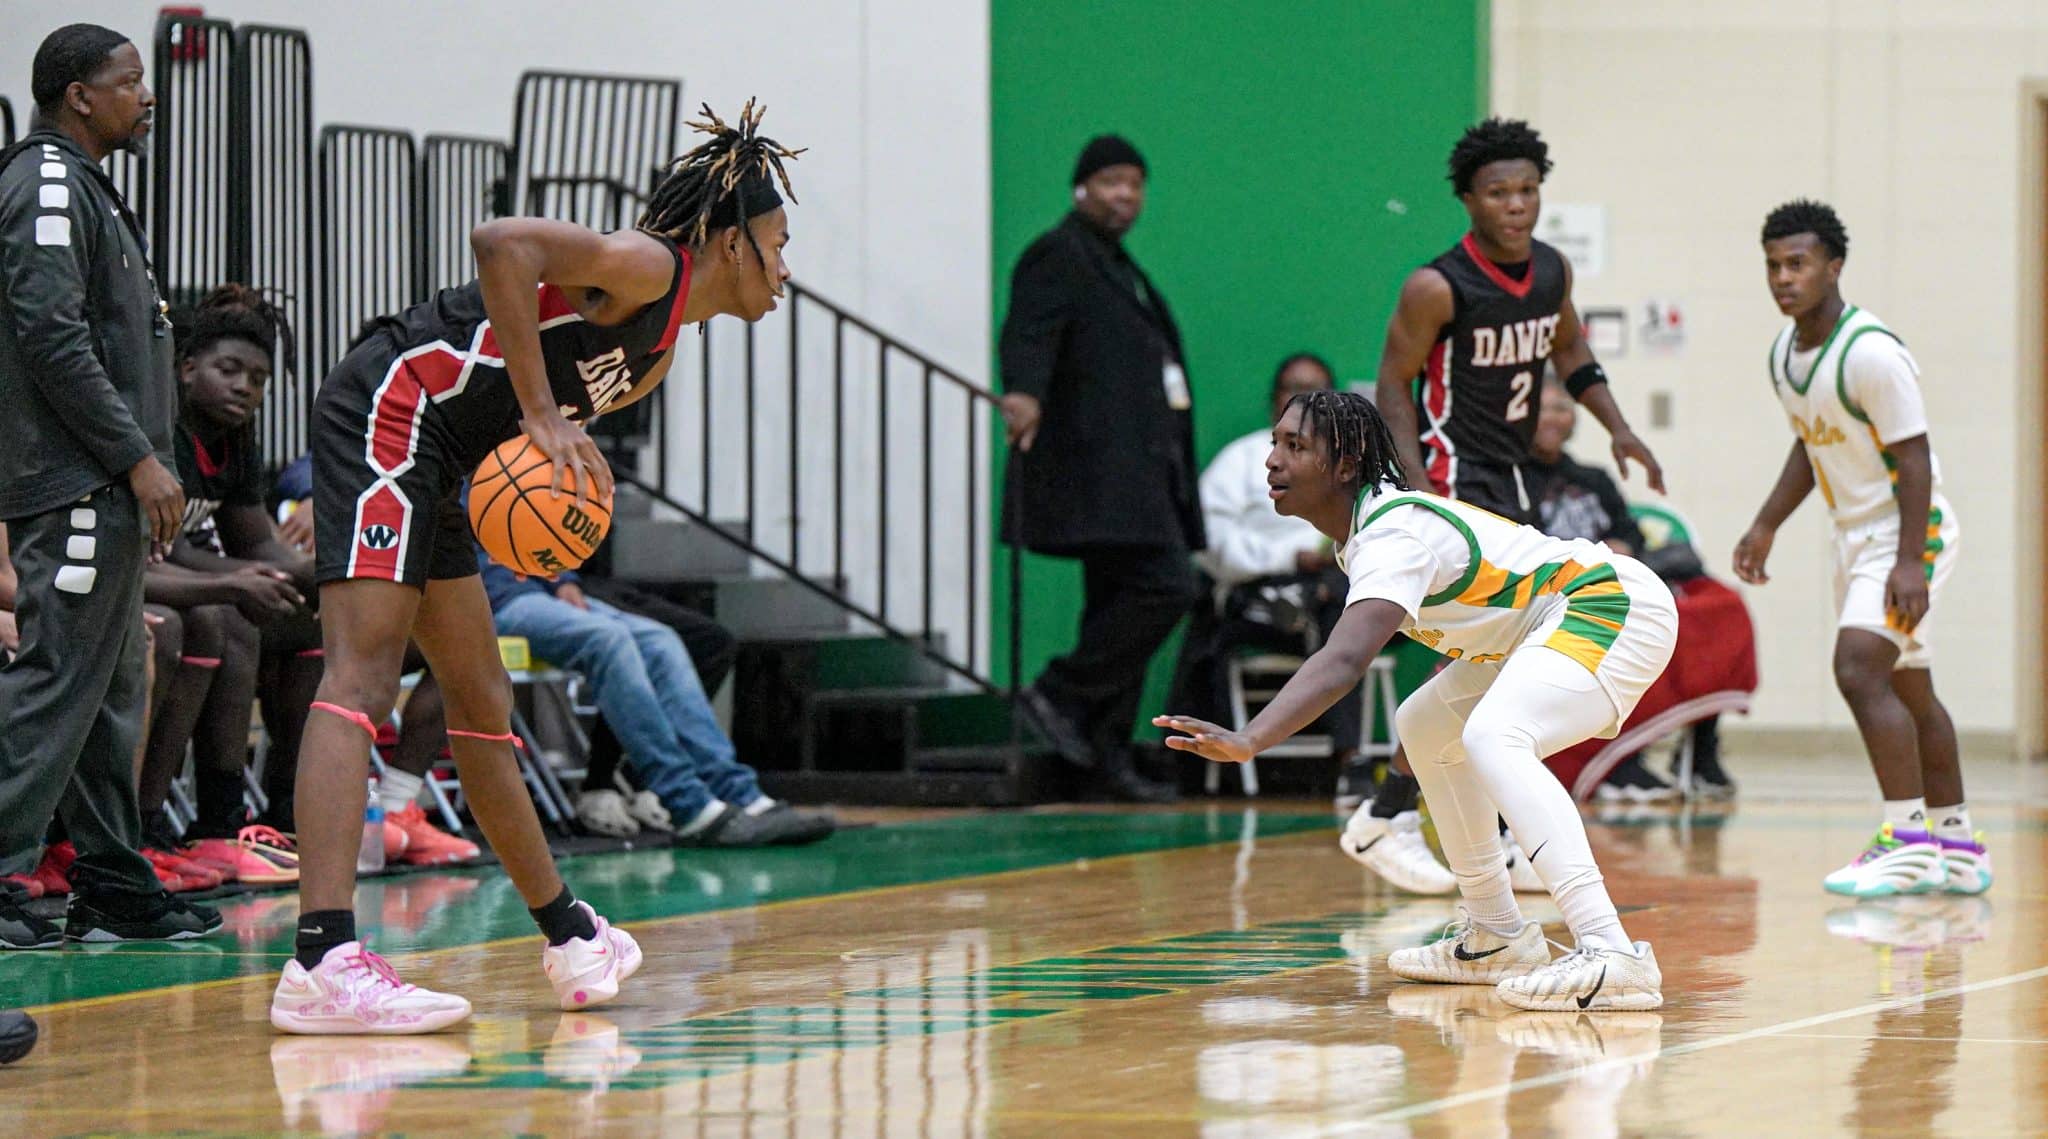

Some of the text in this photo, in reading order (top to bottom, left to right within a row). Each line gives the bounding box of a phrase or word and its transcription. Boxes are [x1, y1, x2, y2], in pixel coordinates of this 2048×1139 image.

[1470, 313, 1561, 367] DAWG
[1506, 370, 1534, 422] 2
[364, 525, 397, 548] W
